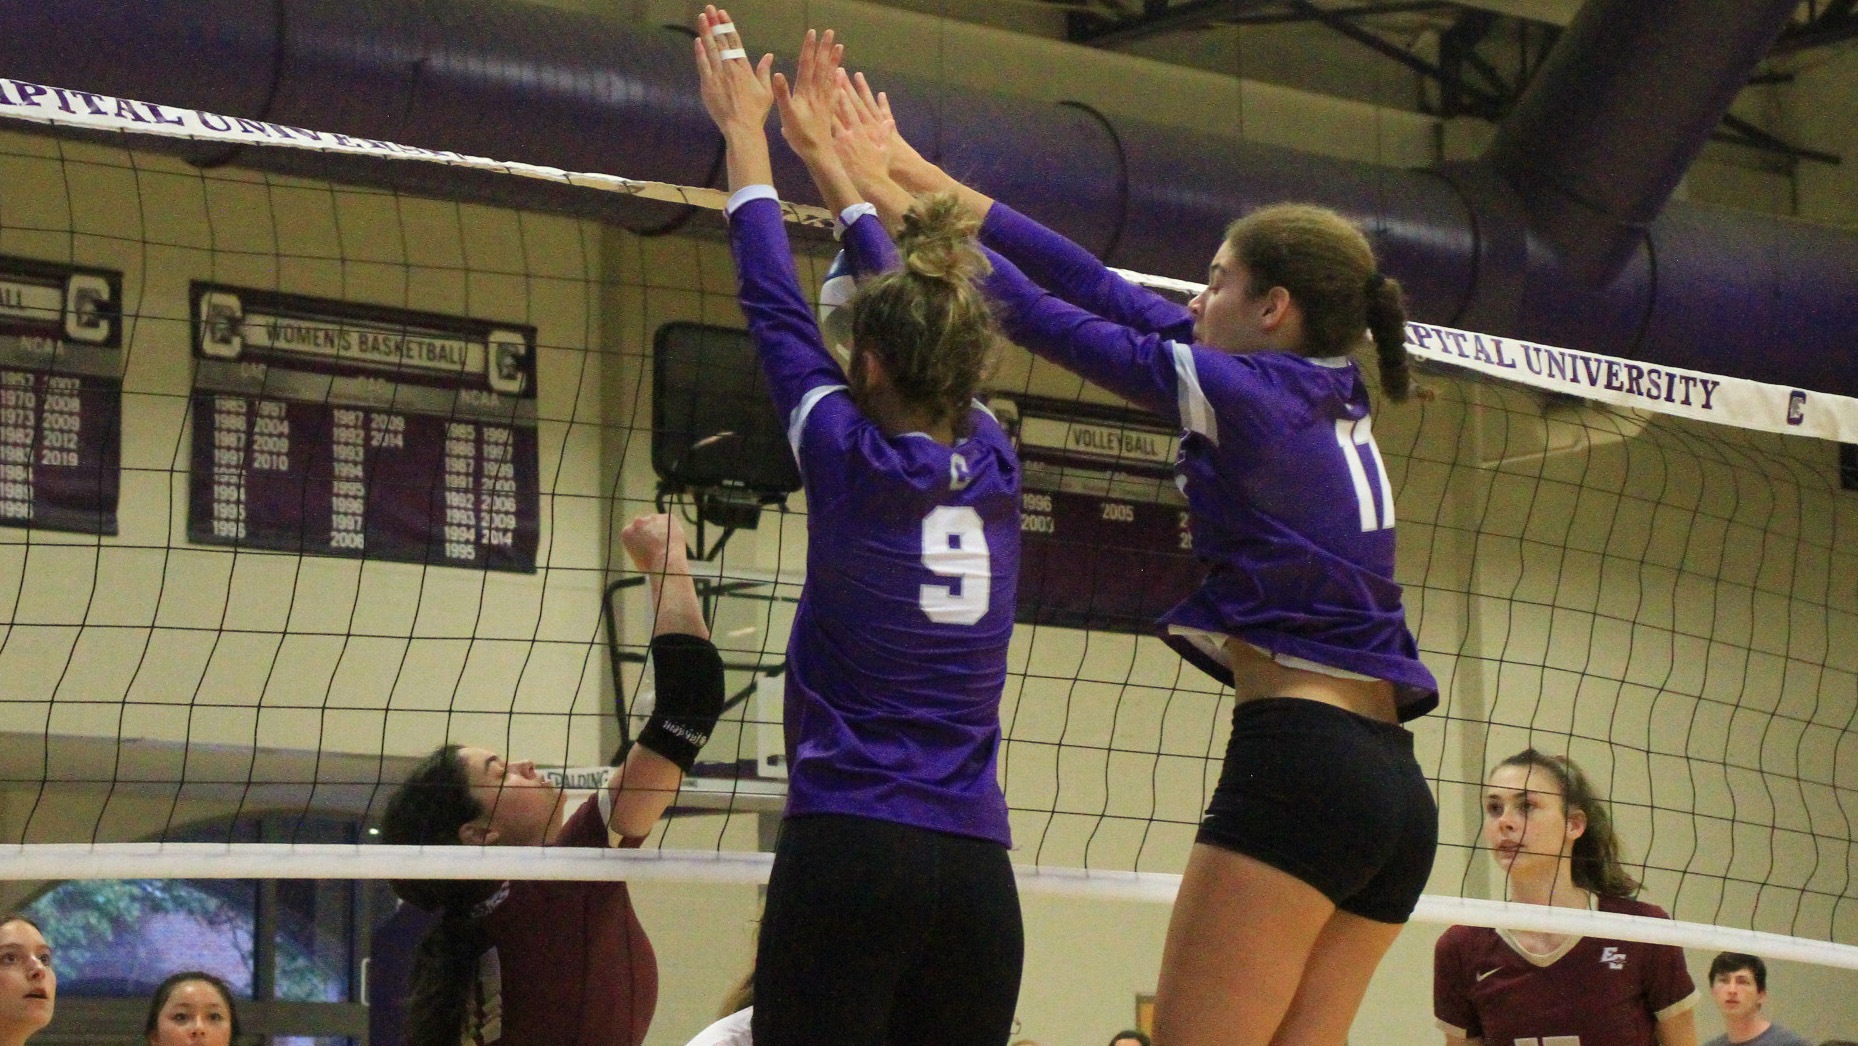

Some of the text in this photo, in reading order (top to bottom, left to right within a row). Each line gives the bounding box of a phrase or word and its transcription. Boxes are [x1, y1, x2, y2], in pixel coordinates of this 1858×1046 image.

[0, 80, 184, 127] PITAL
[265, 318, 466, 365] WOMEN'S BASKETBALL
[1521, 344, 1721, 410] UNIVERSITY
[0, 390, 36, 408] 1970
[0, 408, 35, 426] 1973
[42, 412, 80, 430] 2009
[253, 417, 289, 435] 2004
[0, 426, 34, 444] 1982
[43, 430, 78, 448] 2012
[1072, 428, 1159, 455] VOLLEYBALL
[41, 448, 78, 466] 2019
[252, 452, 289, 470] 2010
[1102, 503, 1135, 522] 2005
[332, 514, 363, 531] 1997
[444, 525, 475, 542] 1994
[481, 529, 512, 547] 2014
[919, 505, 991, 626] 9
